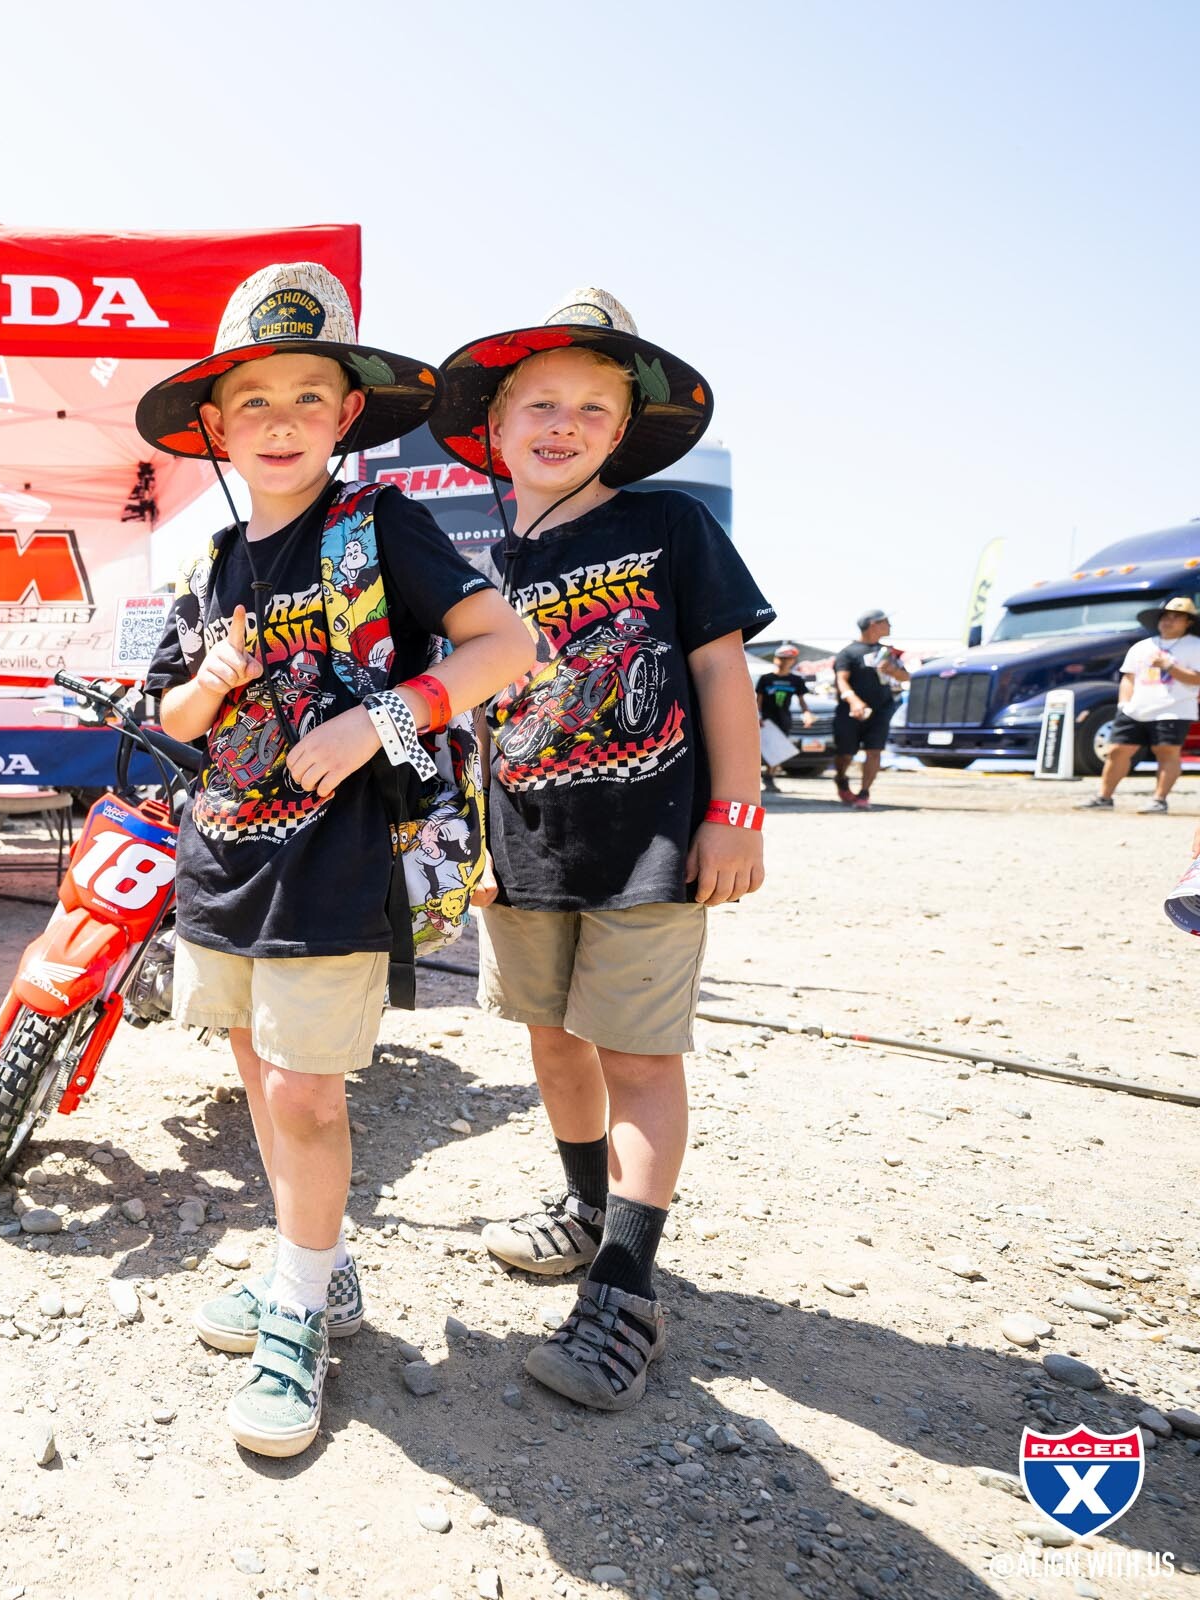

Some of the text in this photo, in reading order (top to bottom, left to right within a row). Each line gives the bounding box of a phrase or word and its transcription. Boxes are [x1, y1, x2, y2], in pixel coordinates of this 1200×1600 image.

[255, 291, 321, 320] FASTHOUSE
[258, 321, 314, 339] CUSTOMS
[376, 463, 490, 493] BHM
[559, 548, 663, 597] FREE
[45, 654, 67, 669] CA
[569, 776, 600, 788] INDIAN
[630, 771, 658, 784] SHADOW
[674, 745, 689, 760] 1972
[72, 830, 178, 910] 18
[91, 897, 119, 915] HONDA
